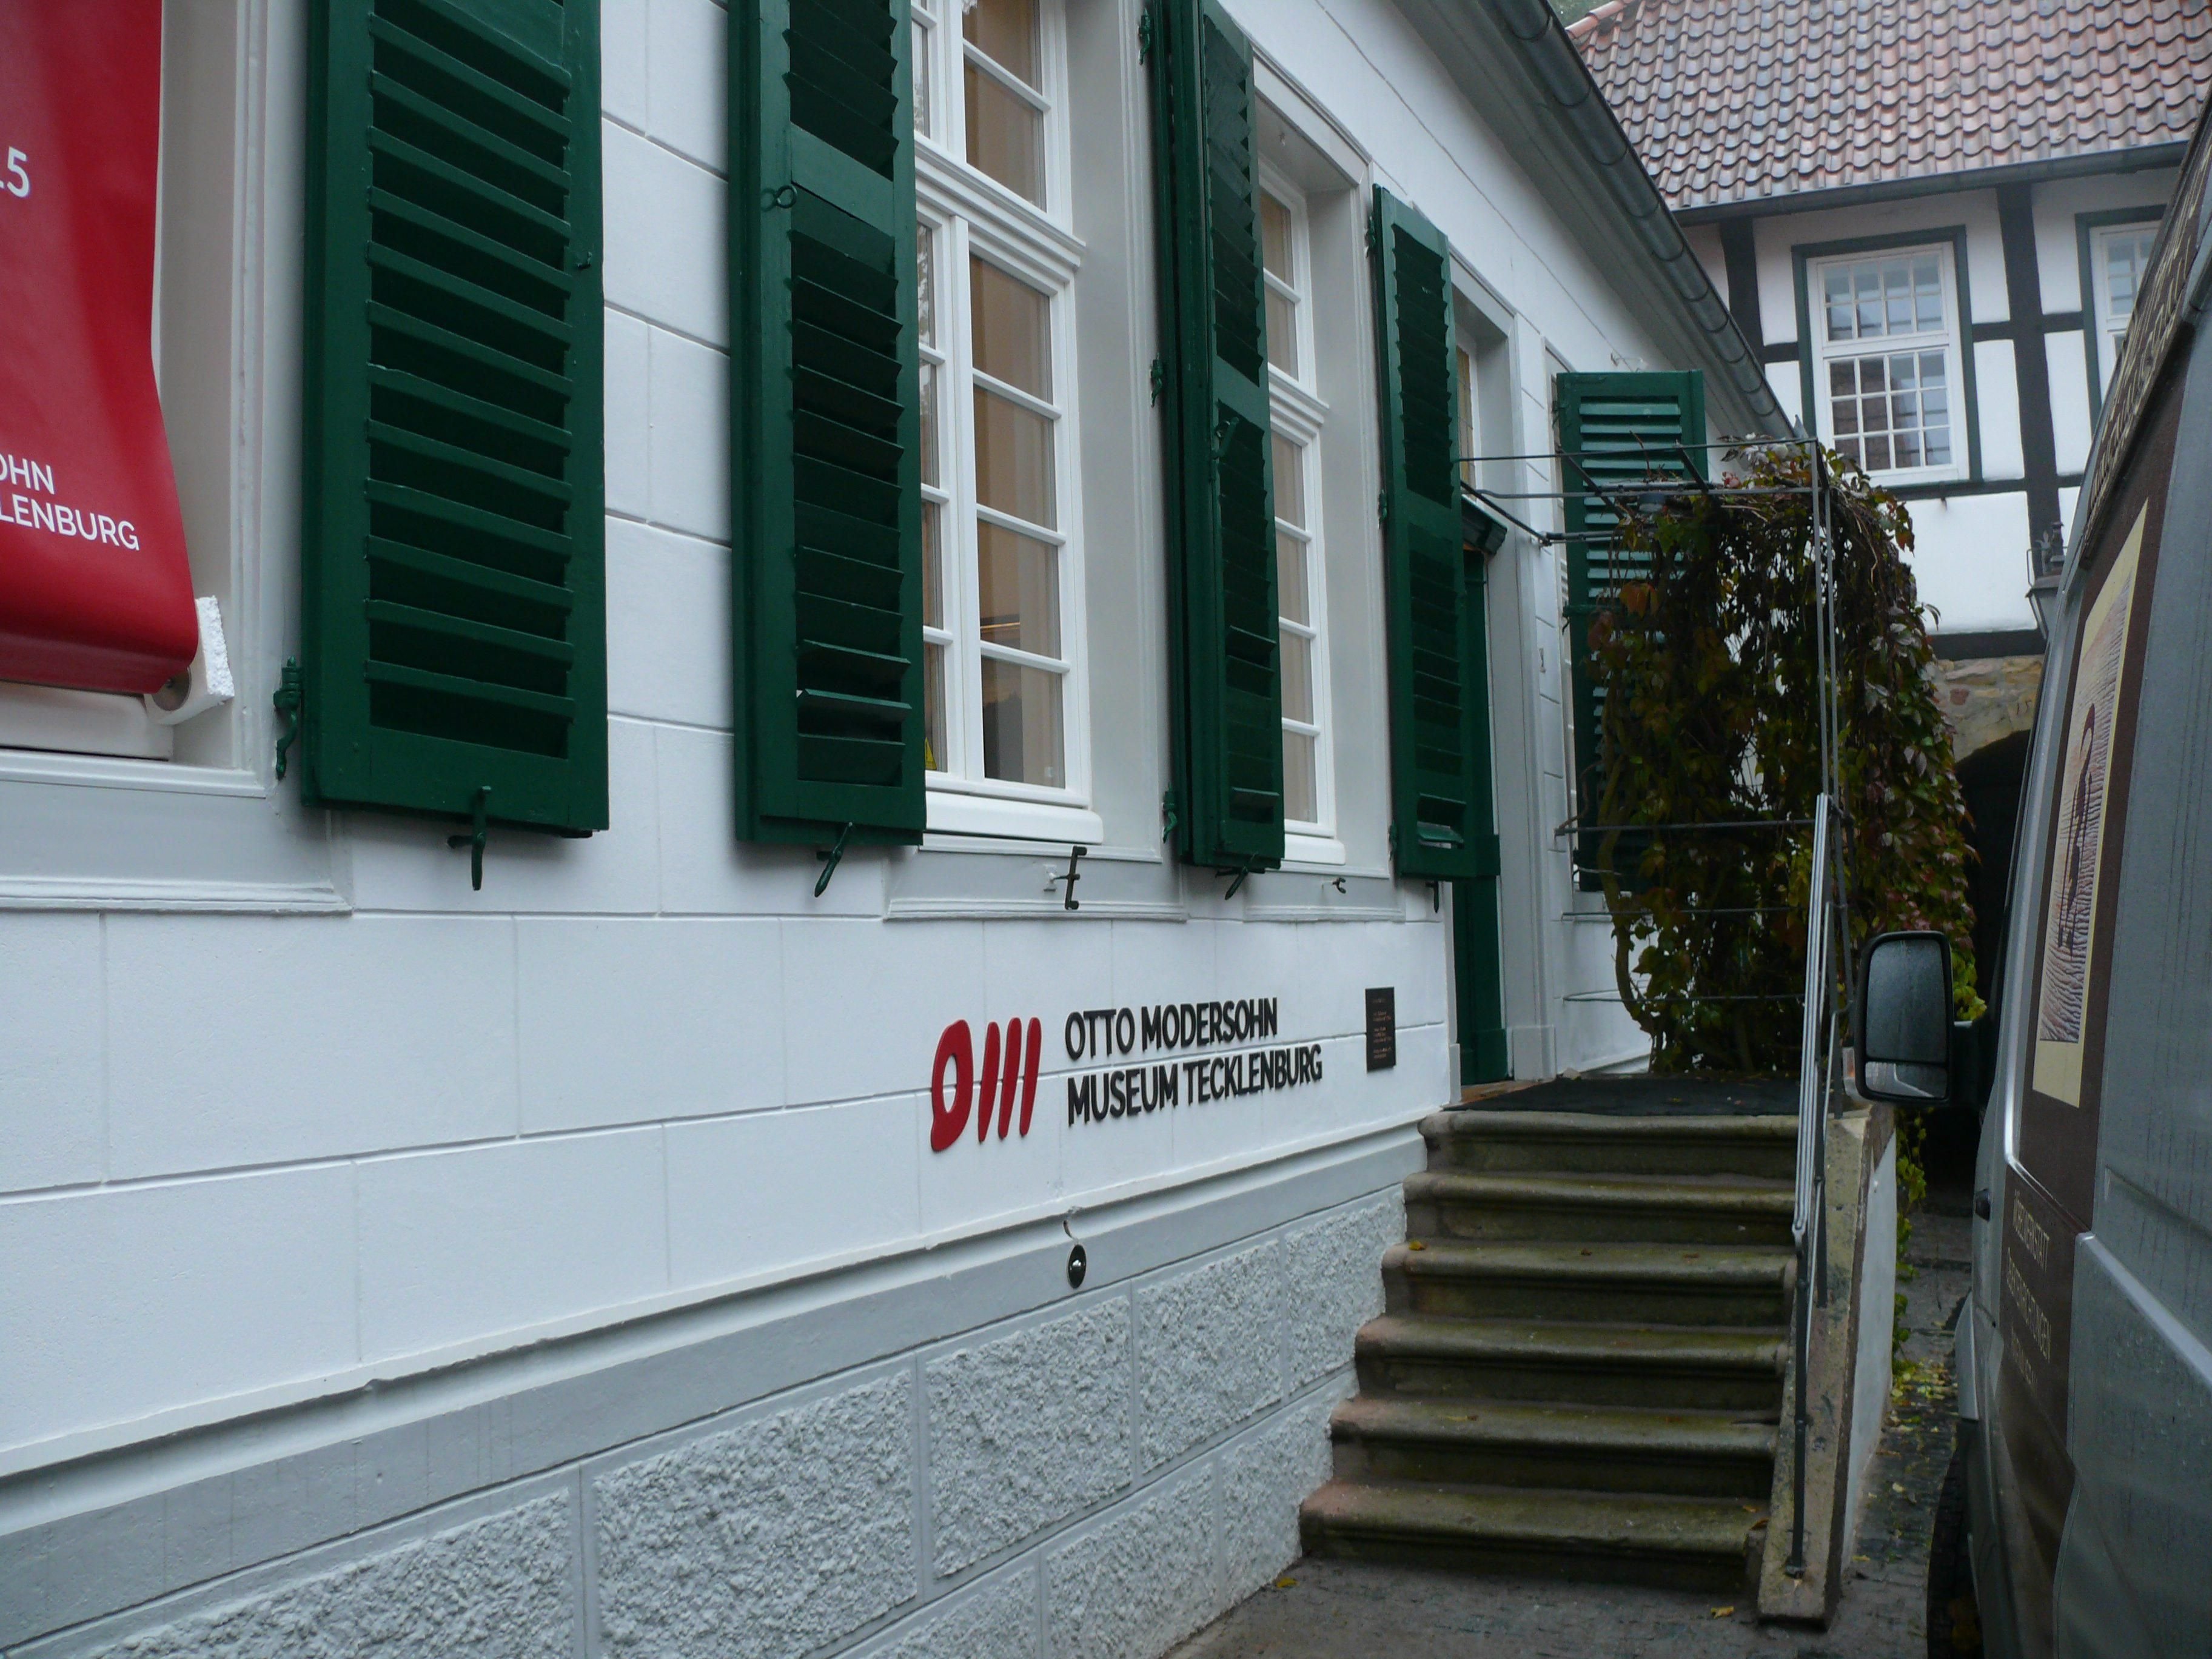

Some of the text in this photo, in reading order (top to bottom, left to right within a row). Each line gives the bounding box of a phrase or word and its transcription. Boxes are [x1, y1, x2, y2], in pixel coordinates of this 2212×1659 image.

[1065, 997, 1278, 1061] OTTO MODERSOHN
[1068, 1044, 1323, 1127] MUSEUM TECKLENBURG
